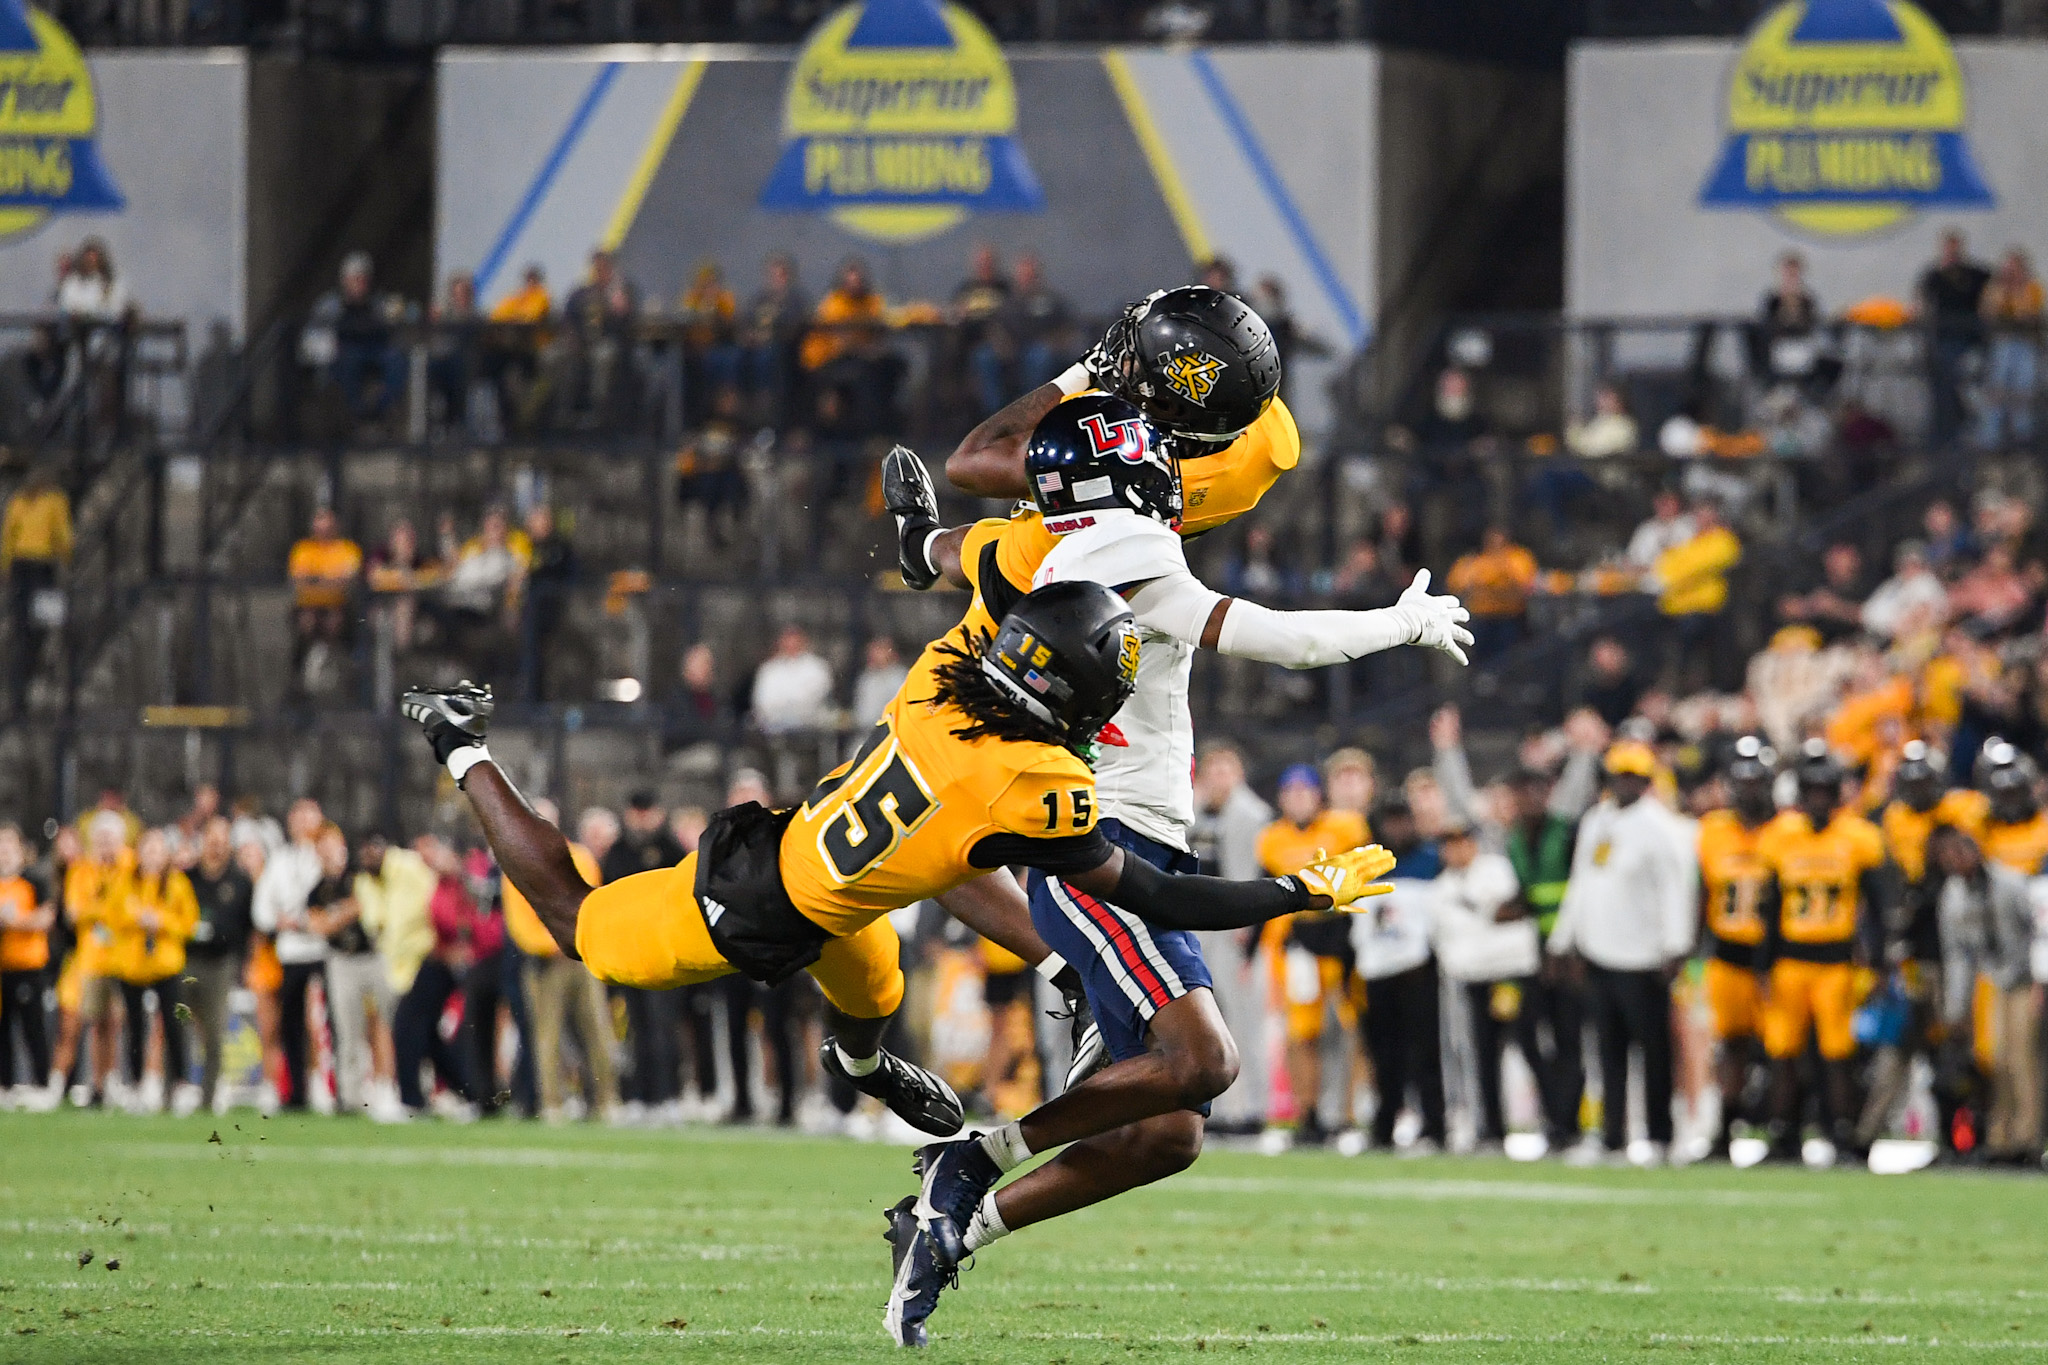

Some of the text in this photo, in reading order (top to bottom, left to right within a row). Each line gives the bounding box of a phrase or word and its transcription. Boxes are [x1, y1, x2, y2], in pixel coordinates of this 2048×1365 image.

[807, 68, 991, 120] Superior
[1745, 64, 1940, 114] Superior
[804, 139, 992, 196] PLUMBING
[1746, 137, 1942, 193] PLUMBING
[1077, 413, 1150, 465] LU
[1016, 632, 1053, 669] 15
[1041, 787, 1098, 834] 15
